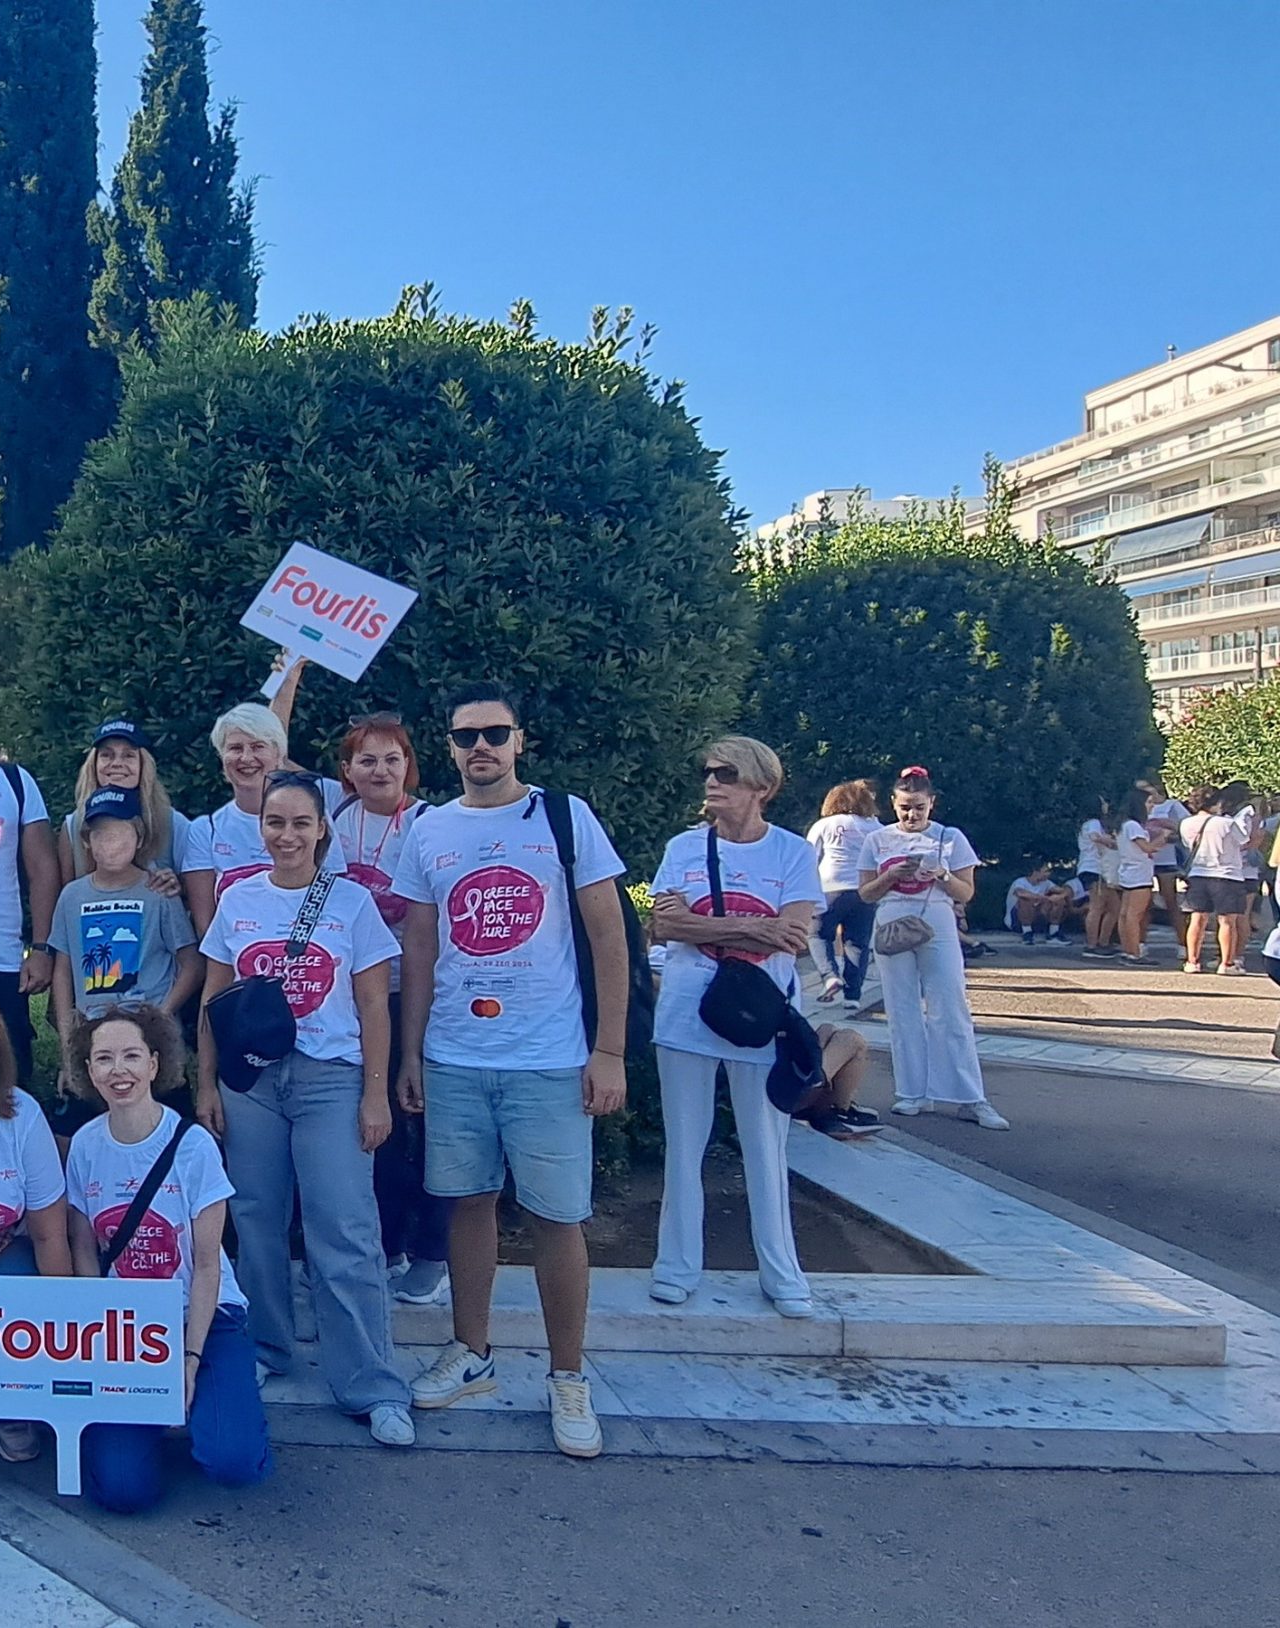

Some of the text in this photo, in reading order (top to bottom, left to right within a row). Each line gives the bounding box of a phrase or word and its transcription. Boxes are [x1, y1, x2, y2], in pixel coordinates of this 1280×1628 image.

[271, 565, 388, 639] Fourlis
[91, 791, 124, 807] FOURLIS
[484, 886, 530, 899] GREECE
[83, 905, 111, 913] Malibu
[509, 913, 533, 925] THE
[282, 981, 322, 992] OR THE
[5, 1382, 44, 1390] INTERSPORT
[128, 1387, 169, 1395] LOGISTICS
